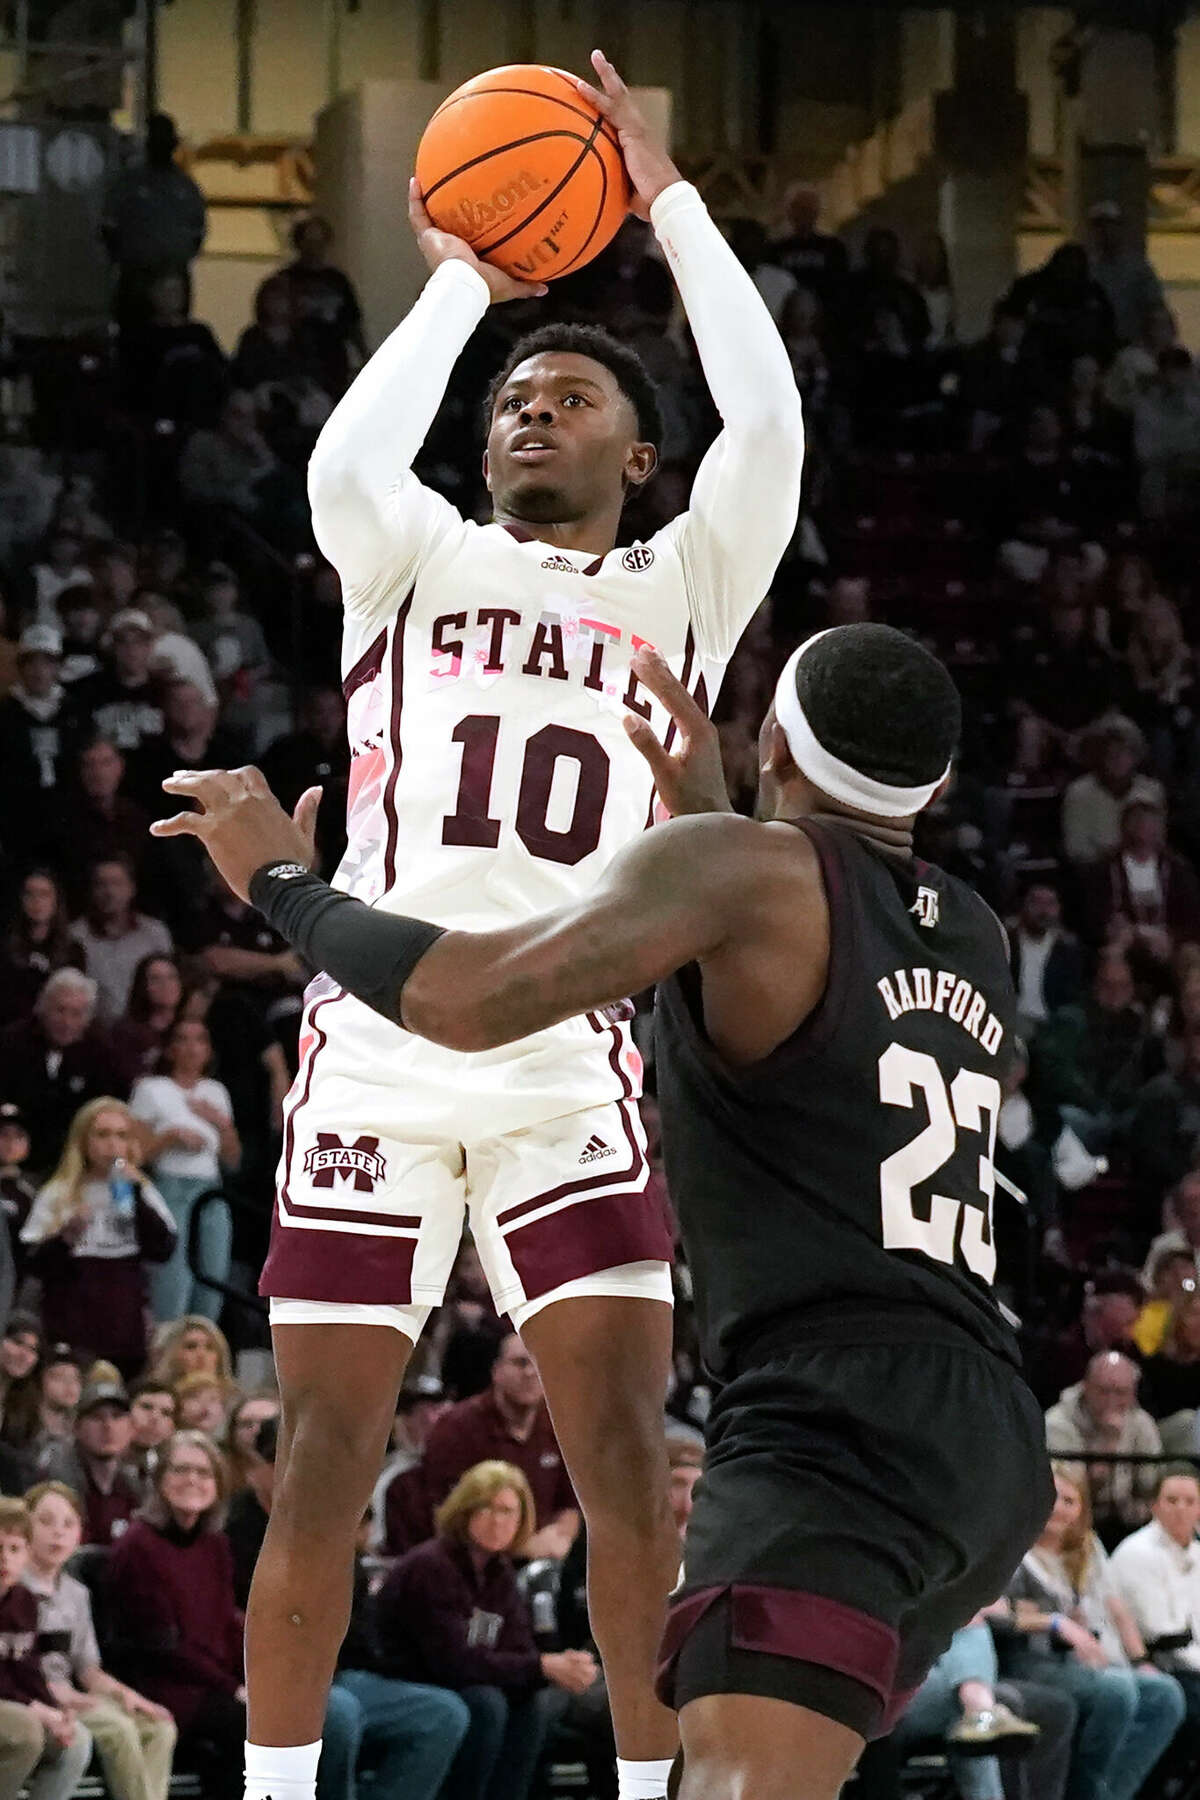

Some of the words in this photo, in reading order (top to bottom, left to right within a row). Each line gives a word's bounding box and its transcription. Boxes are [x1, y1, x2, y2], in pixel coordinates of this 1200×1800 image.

[541, 560, 579, 574] adidas
[625, 549, 650, 570] SEC
[441, 714, 610, 866] 10
[877, 967, 1003, 1056] RADFORD
[318, 1150, 373, 1172] STATE
[578, 1147, 618, 1165] adidas
[878, 1041, 1001, 1286] 23
